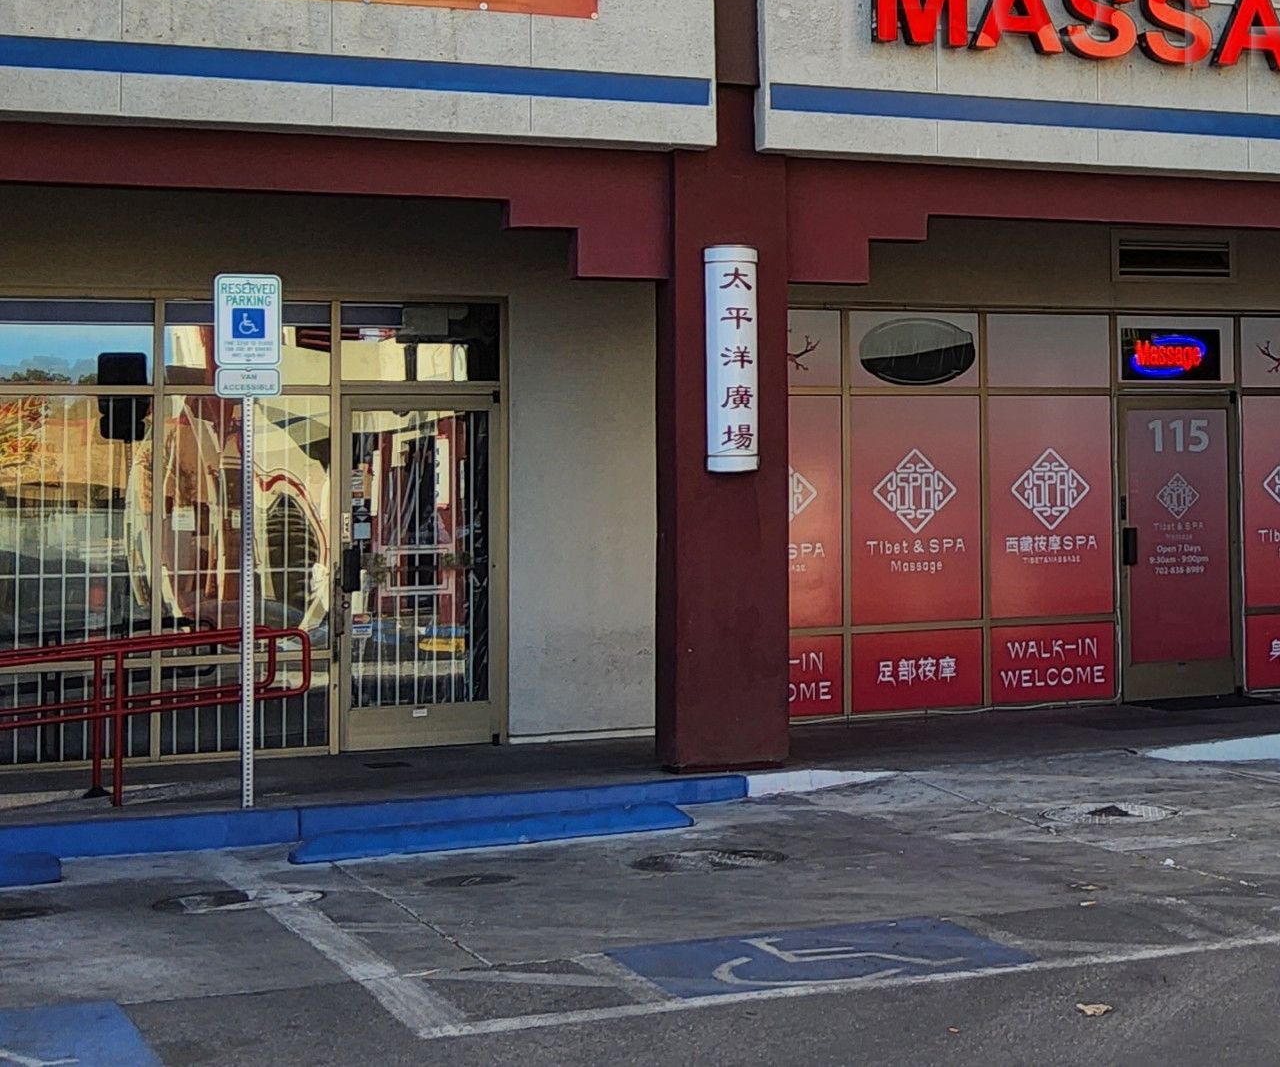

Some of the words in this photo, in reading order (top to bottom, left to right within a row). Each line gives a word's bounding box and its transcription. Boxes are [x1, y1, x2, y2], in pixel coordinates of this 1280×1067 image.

[221, 283, 276, 294] RESERVED
[226, 295, 272, 307] PARKING
[719, 267, 754, 449] 太平洋廣場
[1136, 339, 1202, 370] Massage
[223, 383, 275, 391] ACCESSIBLE
[1149, 419, 1209, 453] 115
[866, 539, 909, 556] Tibet
[913, 539, 926, 552] &
[929, 538, 966, 553] SPA
[1156, 545, 1176, 555] Open
[1178, 544, 1182, 553] 7
[1184, 543, 1202, 554] Days
[890, 560, 943, 574] Massage
[1006, 637, 1098, 662] WALK-IN
[877, 655, 958, 686] 足部按摩
[1000, 665, 1106, 689] WELCOME
